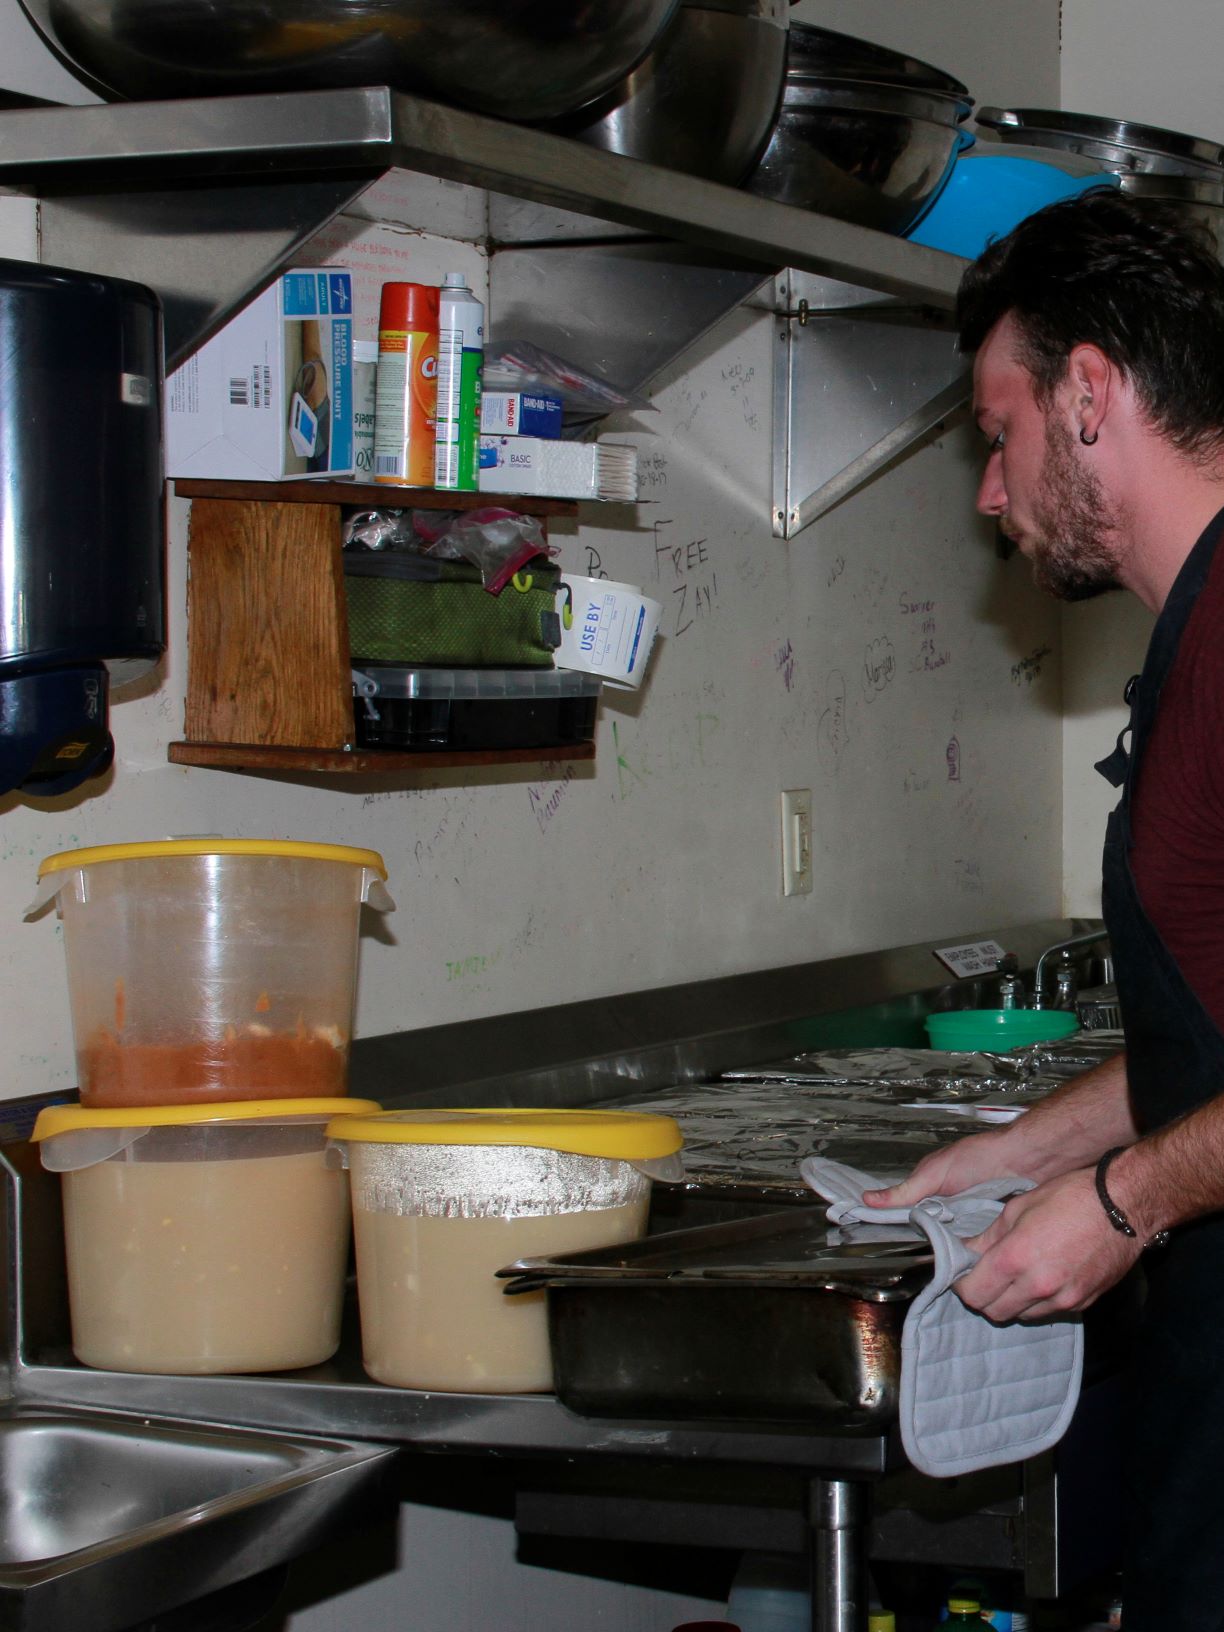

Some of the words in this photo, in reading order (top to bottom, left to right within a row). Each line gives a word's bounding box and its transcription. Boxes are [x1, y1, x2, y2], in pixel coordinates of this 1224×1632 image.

[340, 323, 348, 366] BLOOD
[333, 323, 342, 393] PRESSURE
[333, 395, 342, 421] UNIT
[510, 454, 532, 464] BASIC
[654, 519, 708, 579] FREE
[586, 602, 601, 623] BY
[580, 625, 600, 651] USE
